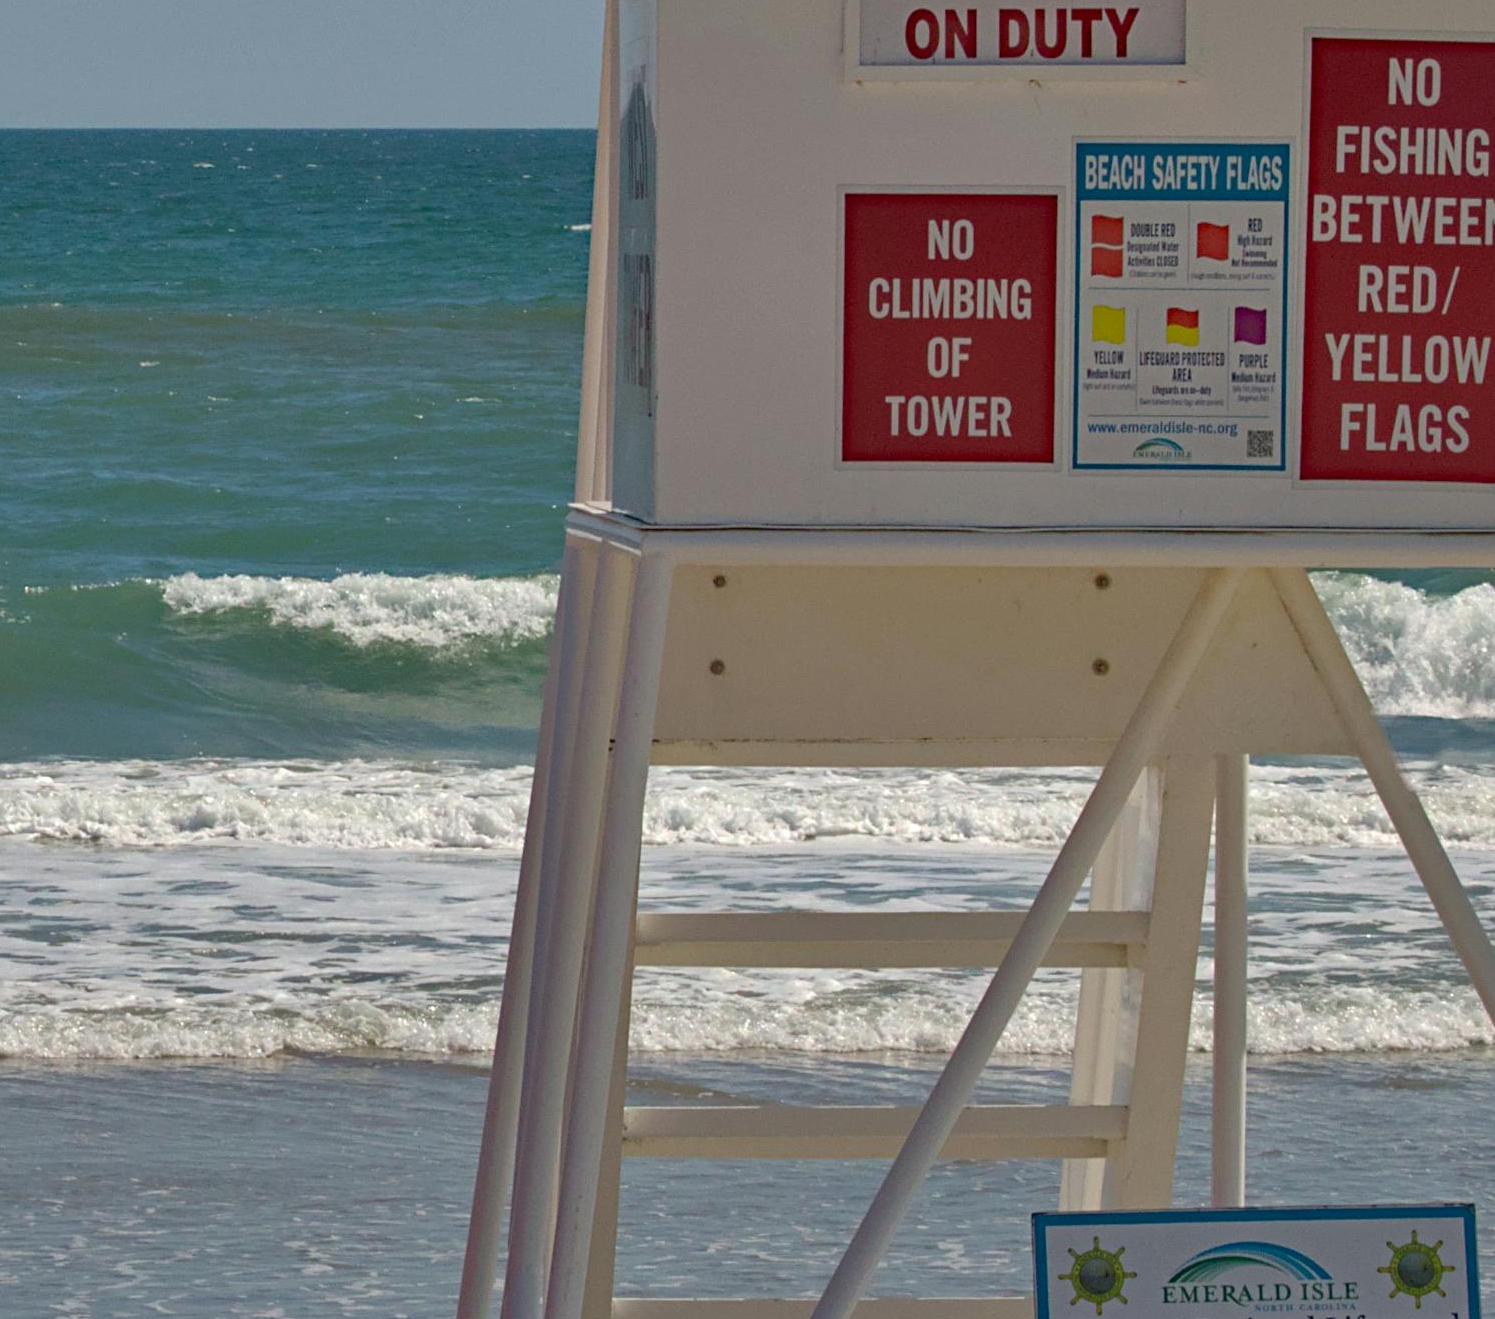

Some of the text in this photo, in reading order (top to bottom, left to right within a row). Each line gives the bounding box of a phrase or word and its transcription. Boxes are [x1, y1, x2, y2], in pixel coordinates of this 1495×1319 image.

[905, 7, 1141, 60] ON DUTY
[1387, 58, 1442, 107] NO
[1335, 127, 1491, 177] FISHING
[1085, 155, 1283, 191] BEACH SAFETY FLAGS
[926, 218, 974, 261] NO
[1130, 223, 1176, 238] DOUBLE RED
[1248, 218, 1263, 232] RED
[1156, 256, 1179, 267] CLOSED
[868, 277, 1033, 322] CLIMBING
[1357, 265, 1459, 315] RED/
[926, 336, 973, 379] OF
[1094, 350, 1124, 365] YELLOW
[1139, 351, 1225, 367] LIFEGUARD PROTECTED
[1172, 368, 1192, 382] AREA
[1239, 354, 1268, 369] PURPLE
[1325, 334, 1492, 385] YELLOW
[884, 396, 1013, 438] TOWER
[1088, 422, 1238, 437] www.emeraldisle-nc.org
[1339, 403, 1471, 455] FLAGS
[1161, 1282, 1359, 1307] EMERALD ISLE
[1254, 1303, 1356, 1313] NORTH CAROLINA
